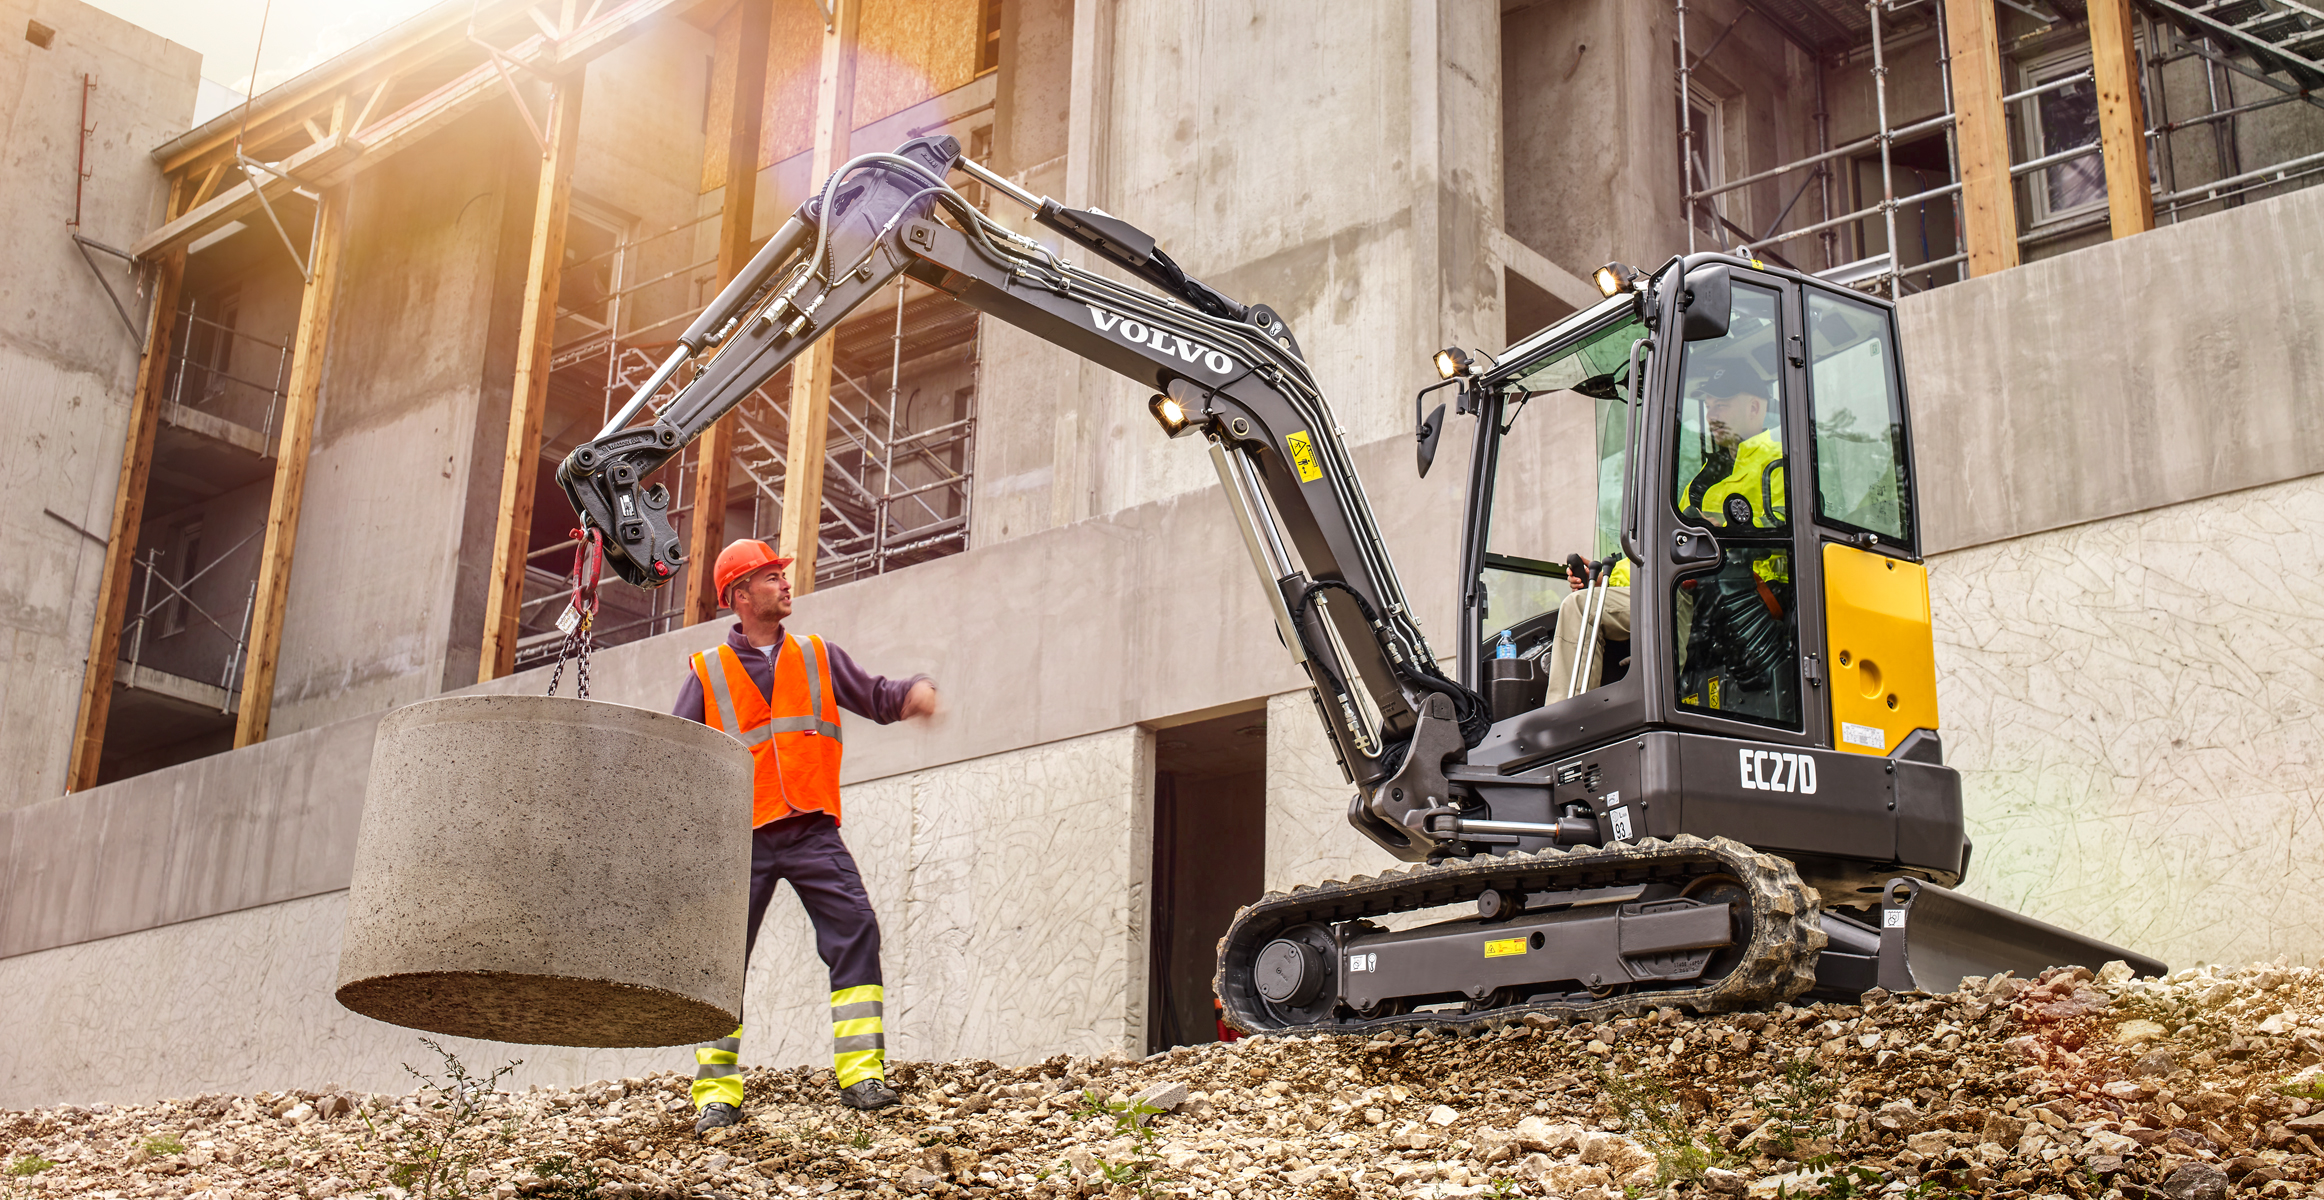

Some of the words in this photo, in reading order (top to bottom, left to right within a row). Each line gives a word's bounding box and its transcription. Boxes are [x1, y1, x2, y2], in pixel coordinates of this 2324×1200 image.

[1086, 304, 1233, 374] VOLVO
[1739, 748, 1817, 794] EC27D
[1615, 821, 1626, 839] 93
